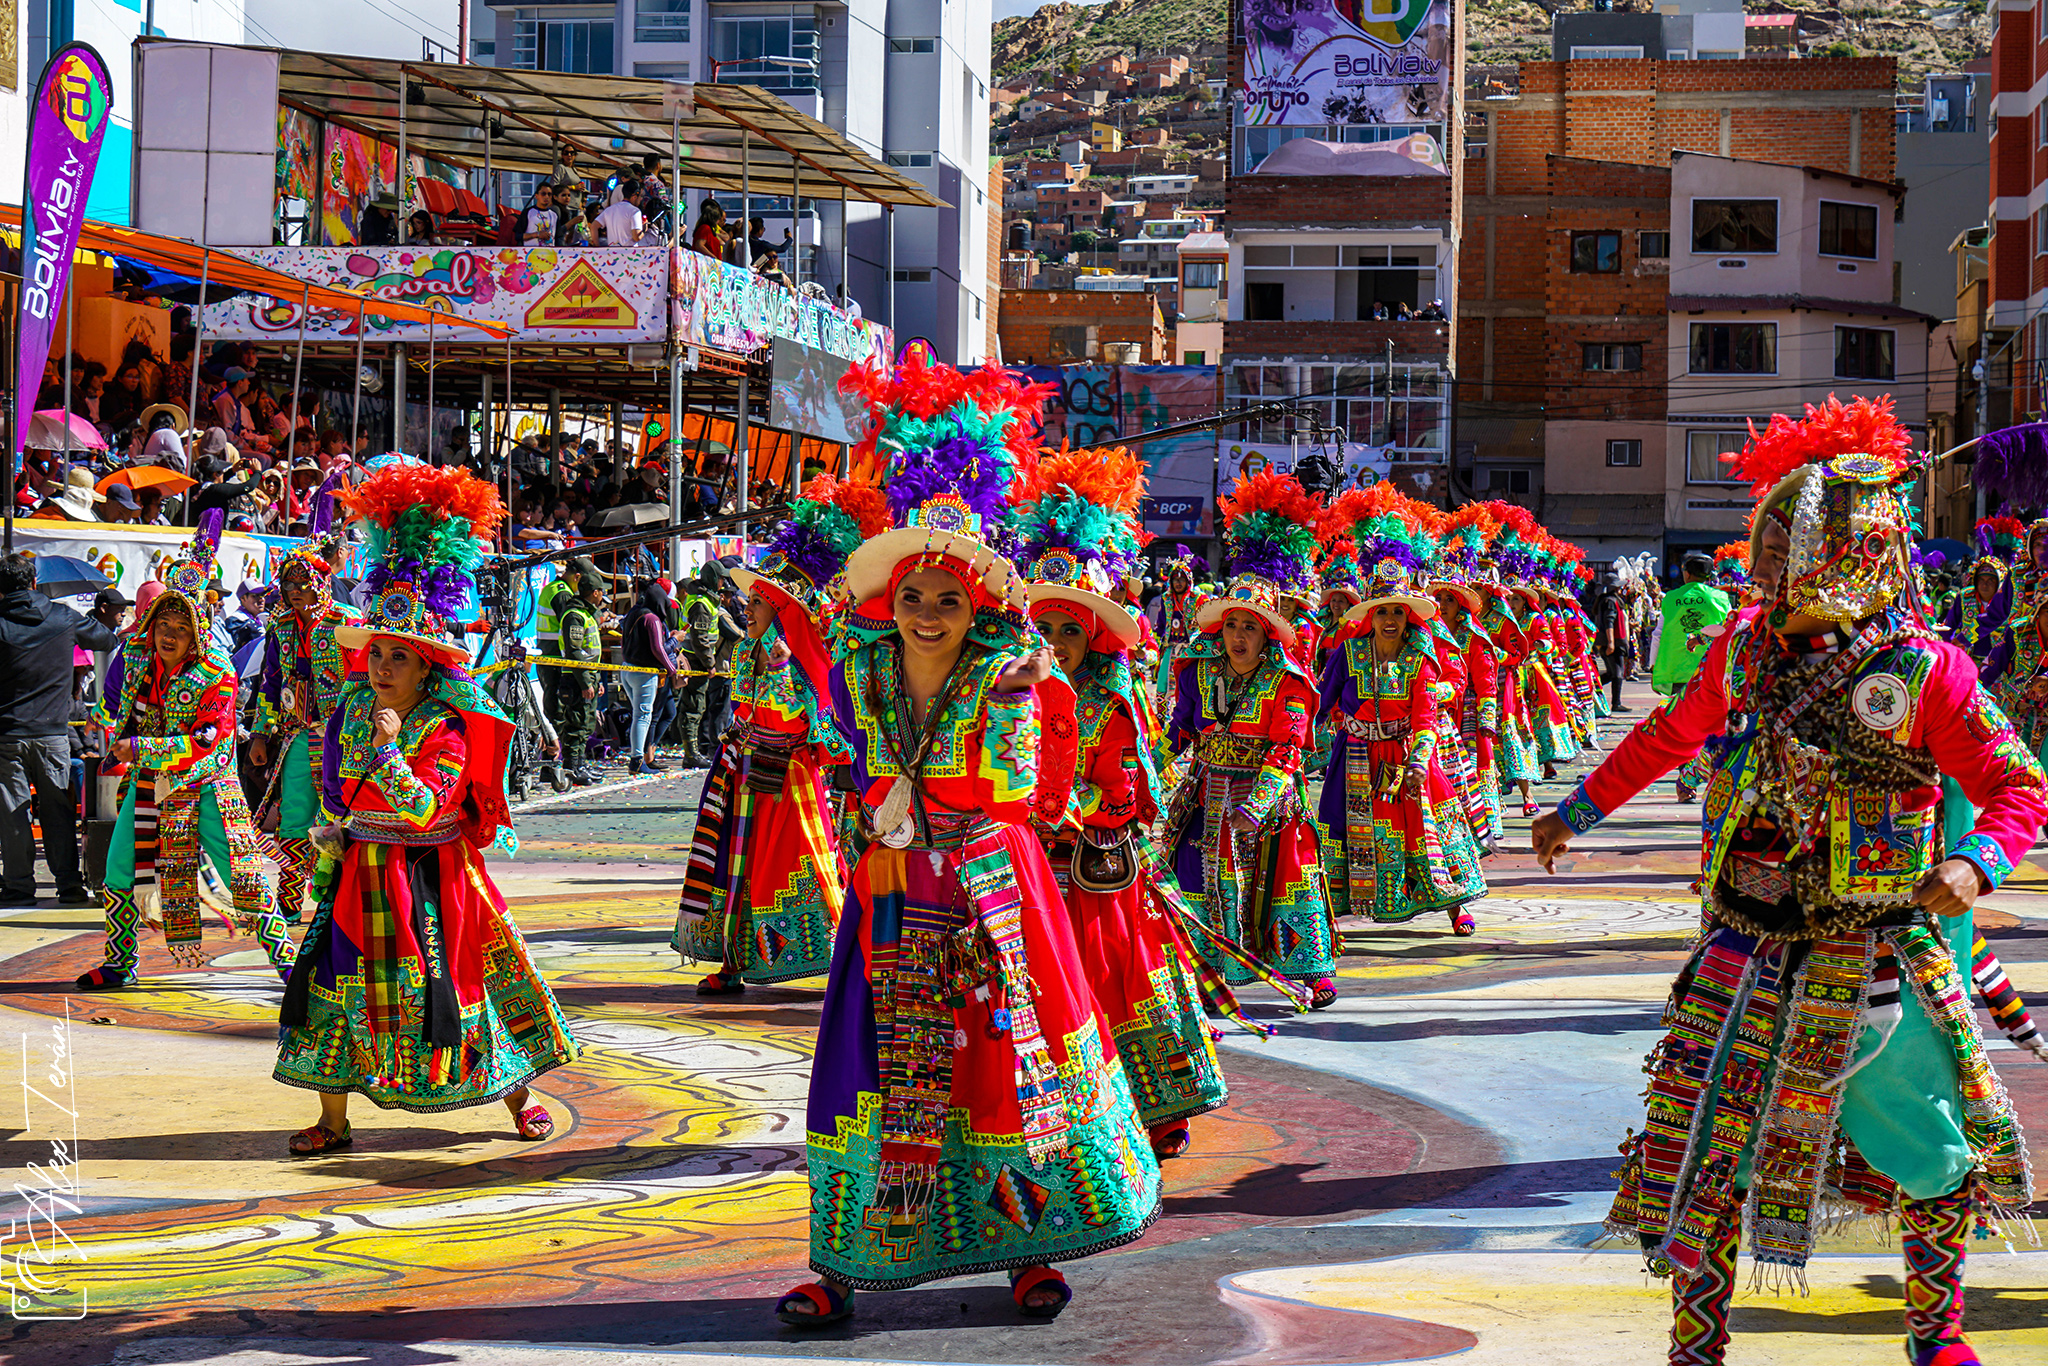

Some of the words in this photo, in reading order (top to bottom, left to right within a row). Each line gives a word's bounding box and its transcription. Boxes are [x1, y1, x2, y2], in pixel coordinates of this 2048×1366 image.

[1334, 52, 1421, 77] Bolivia
[1423, 57, 1442, 74] tv
[1373, 77, 1395, 87] Todos
[23, 177, 73, 320] Bolivia
[59, 147, 79, 177] tv
[551, 269, 580, 298] PATRIMONIO
[585, 270, 613, 298] INTANGIBLE
[1160, 502, 1187, 515] BCP
